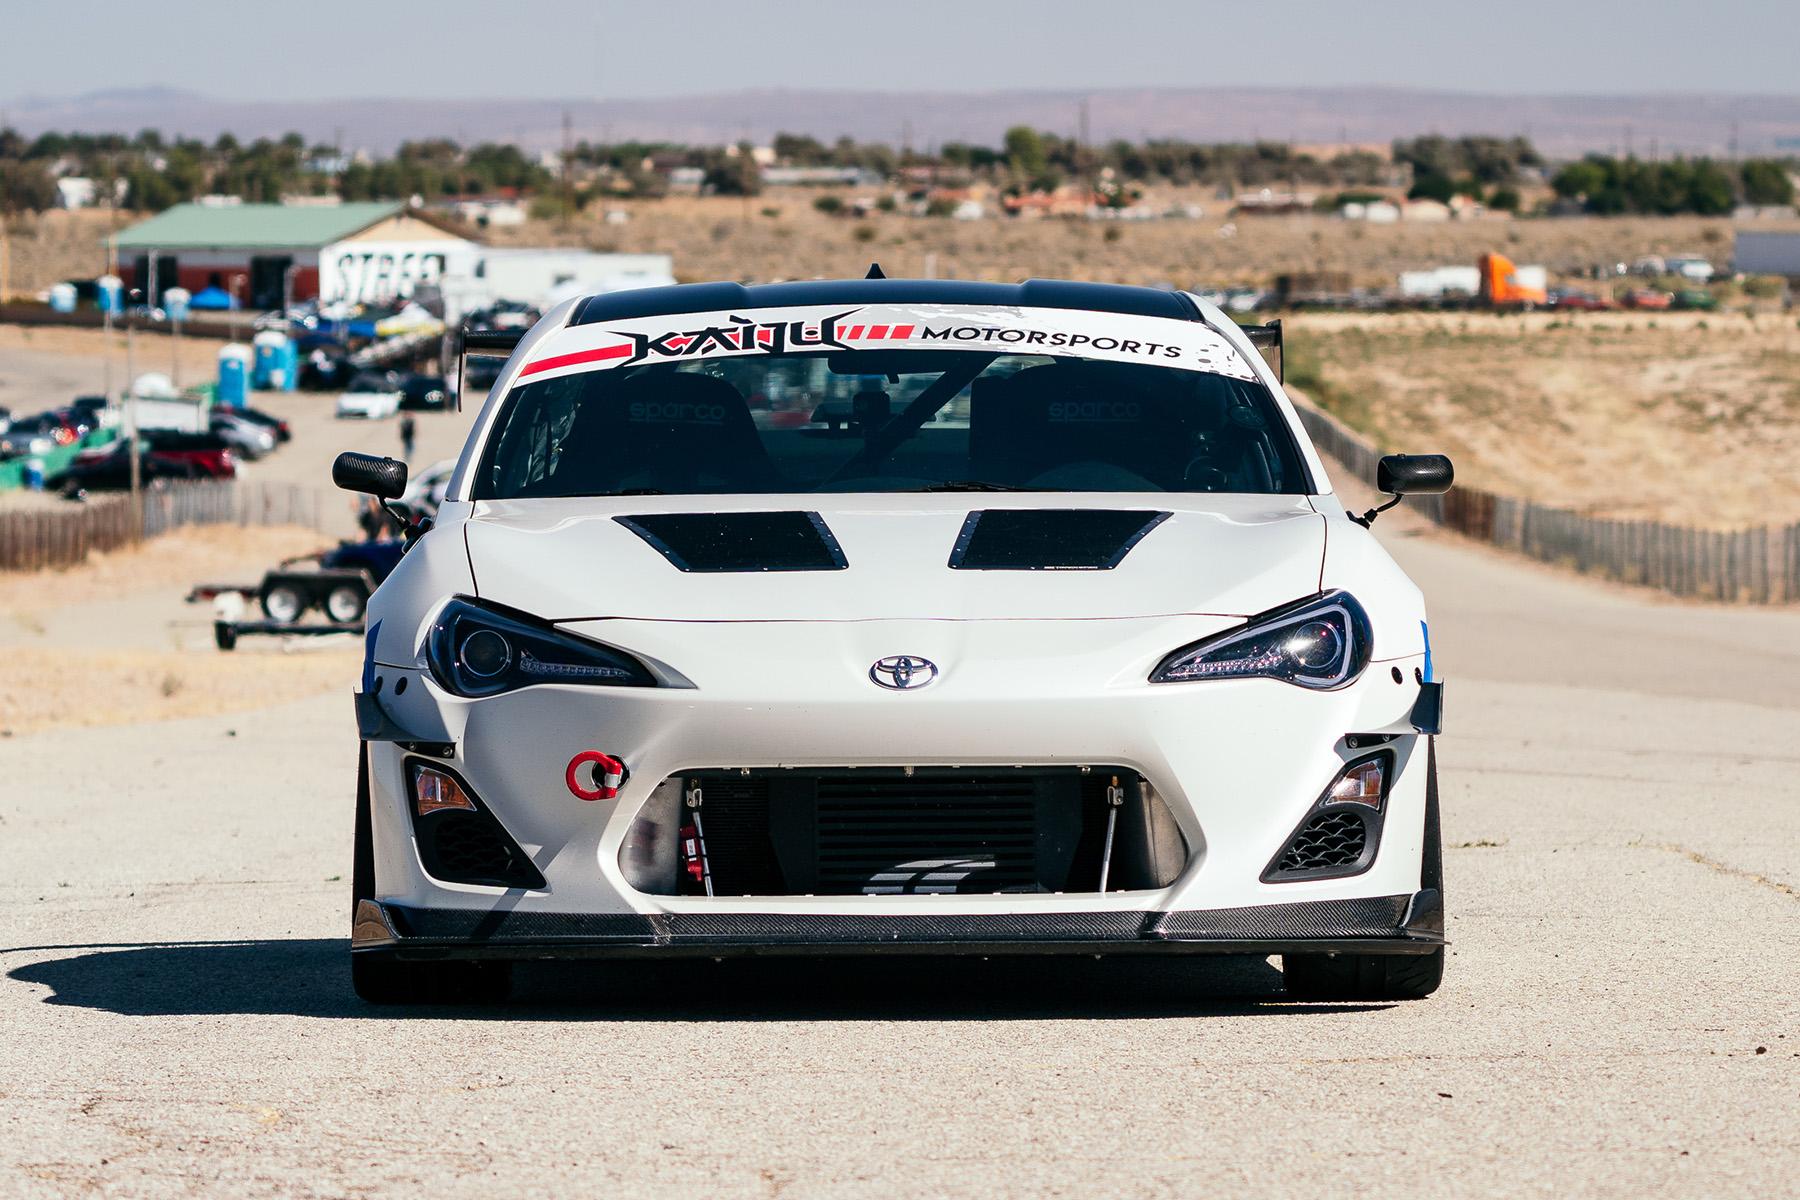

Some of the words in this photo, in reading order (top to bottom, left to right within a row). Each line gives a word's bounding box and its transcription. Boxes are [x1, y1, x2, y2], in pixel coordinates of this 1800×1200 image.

[921, 326, 1182, 358] MOTORSPORTS
[629, 402, 725, 424] sparco
[1048, 402, 1140, 423] sparco
